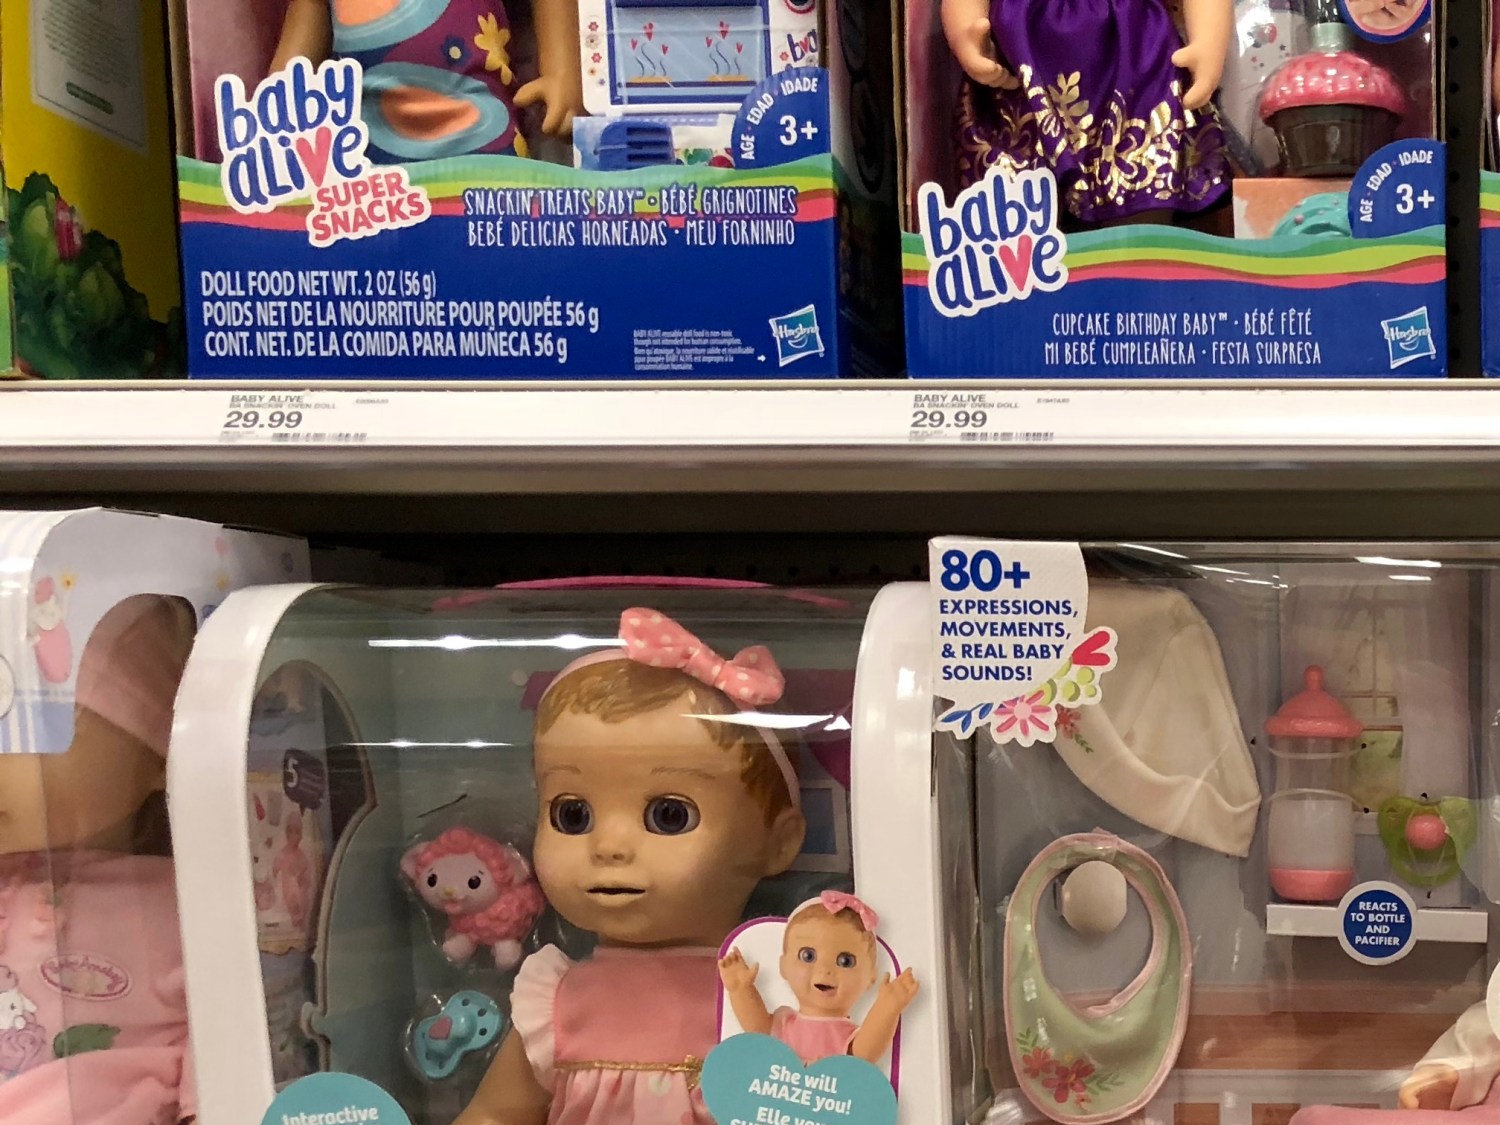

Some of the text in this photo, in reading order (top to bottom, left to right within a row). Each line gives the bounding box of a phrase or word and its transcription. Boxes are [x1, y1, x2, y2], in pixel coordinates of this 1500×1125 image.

[220, 63, 354, 151] baby
[779, 115, 818, 146] 3+
[316, 172, 407, 213] SUPER
[539, 188, 590, 216] TREATS
[661, 184, 696, 215] BÉBÉ
[702, 188, 797, 215] GRIGNOTINES
[1360, 150, 1434, 223] AGE EDAD IDADE
[1396, 184, 1435, 214] 3+
[311, 192, 425, 241] SNACKS
[927, 174, 1051, 258] baby
[201, 269, 437, 299] DOLL FOOD NET WT. 2 OZ (56 g)
[1052, 312, 1111, 335] CUPCAKE
[1117, 312, 1177, 335] BIRTHDAY
[1244, 308, 1275, 335] BÉBÉ
[1282, 308, 1312, 335] FÊTÉ
[231, 394, 304, 403] BABY ALIVE
[914, 394, 986, 402] BABY ALIVE
[224, 410, 304, 429] 29.99
[910, 410, 988, 428] 29.99
[940, 549, 1031, 592] 80+
[939, 599, 1079, 618] EXPRESSIONS,
[940, 621, 1071, 640] MOVEMENTS,
[941, 643, 1065, 659] & REAL BABY
[942, 665, 1033, 681] SOUNDS!
[1350, 912, 1406, 923] TO BOTTLE
[1359, 901, 1398, 912] REACTS
[1354, 935, 1401, 946] PACIFIER
[1365, 924, 1390, 934] AND
[769, 1064, 838, 1094] She will
[748, 1079, 852, 1115] AMAZE you!
